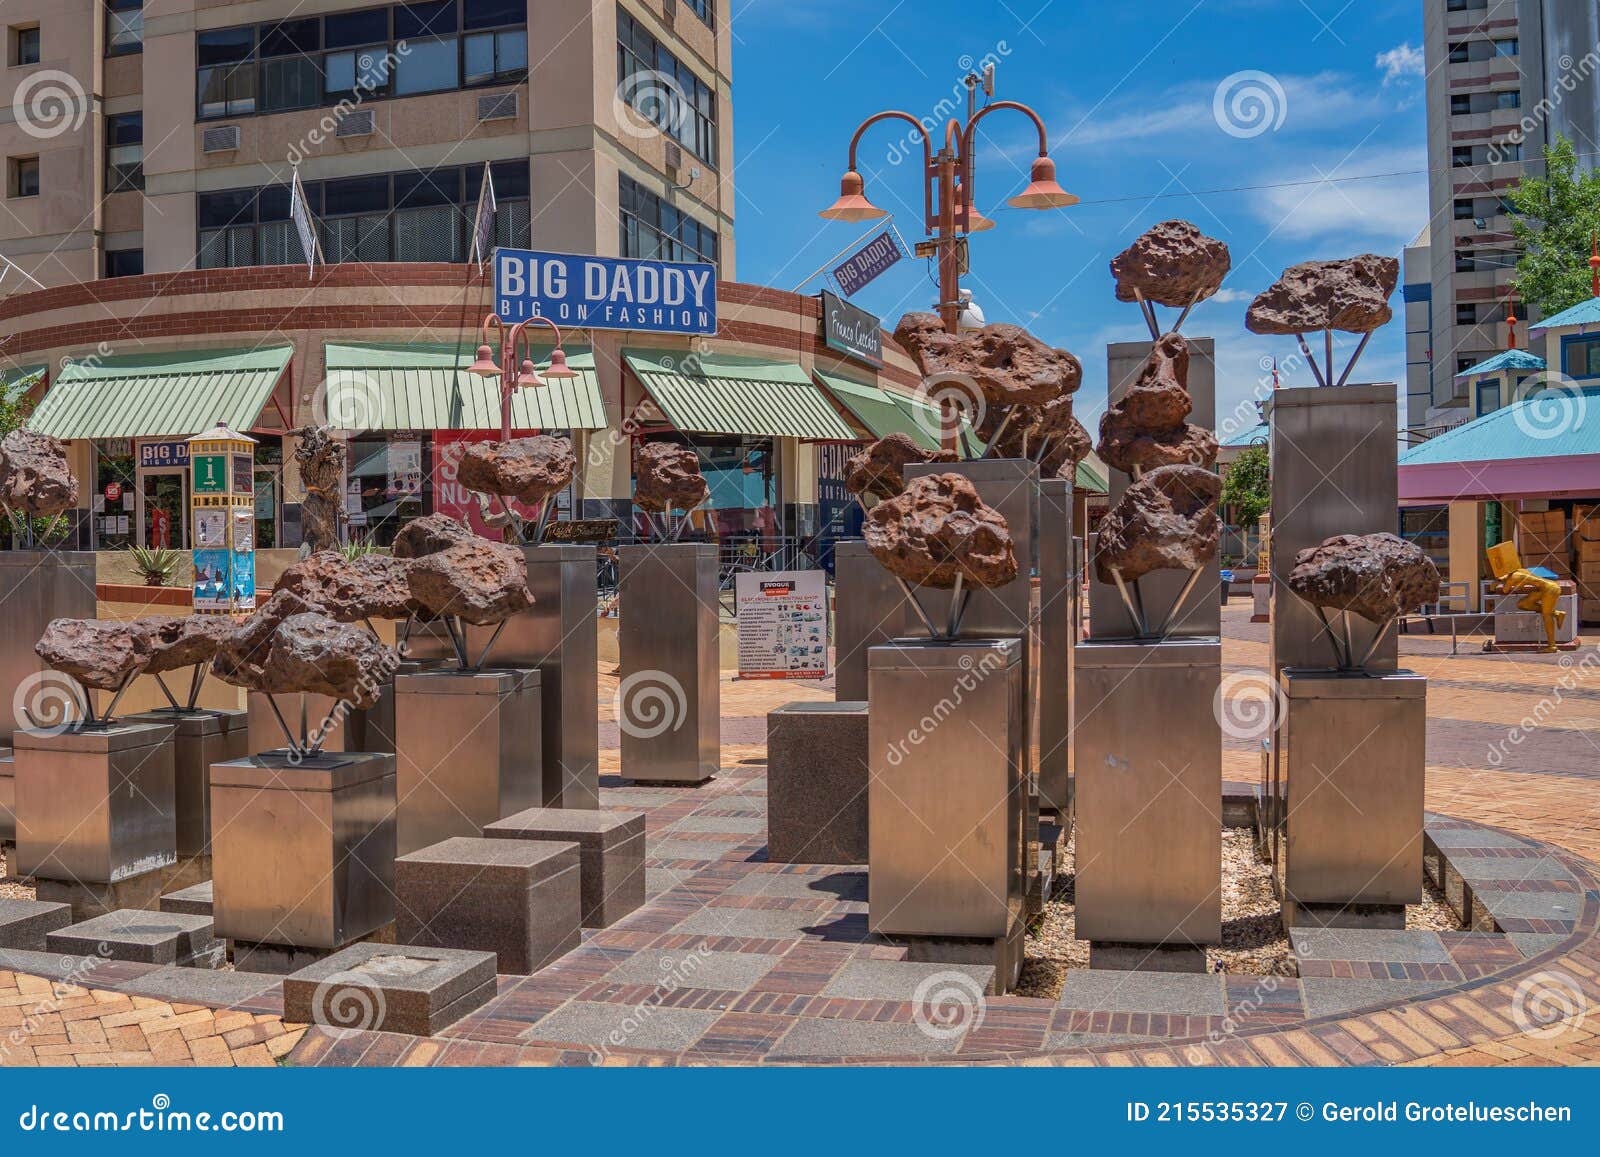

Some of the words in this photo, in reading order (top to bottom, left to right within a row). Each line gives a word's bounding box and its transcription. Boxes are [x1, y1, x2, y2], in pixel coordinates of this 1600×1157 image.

[836, 263, 858, 287] BIG
[855, 235, 892, 272] DADDY
[501, 256, 567, 299] BIG
[584, 261, 710, 307] DADDY
[501, 300, 541, 317] BIG
[560, 303, 588, 320] ON
[605, 306, 708, 327] FASHION
[143, 445, 170, 459] BIG
